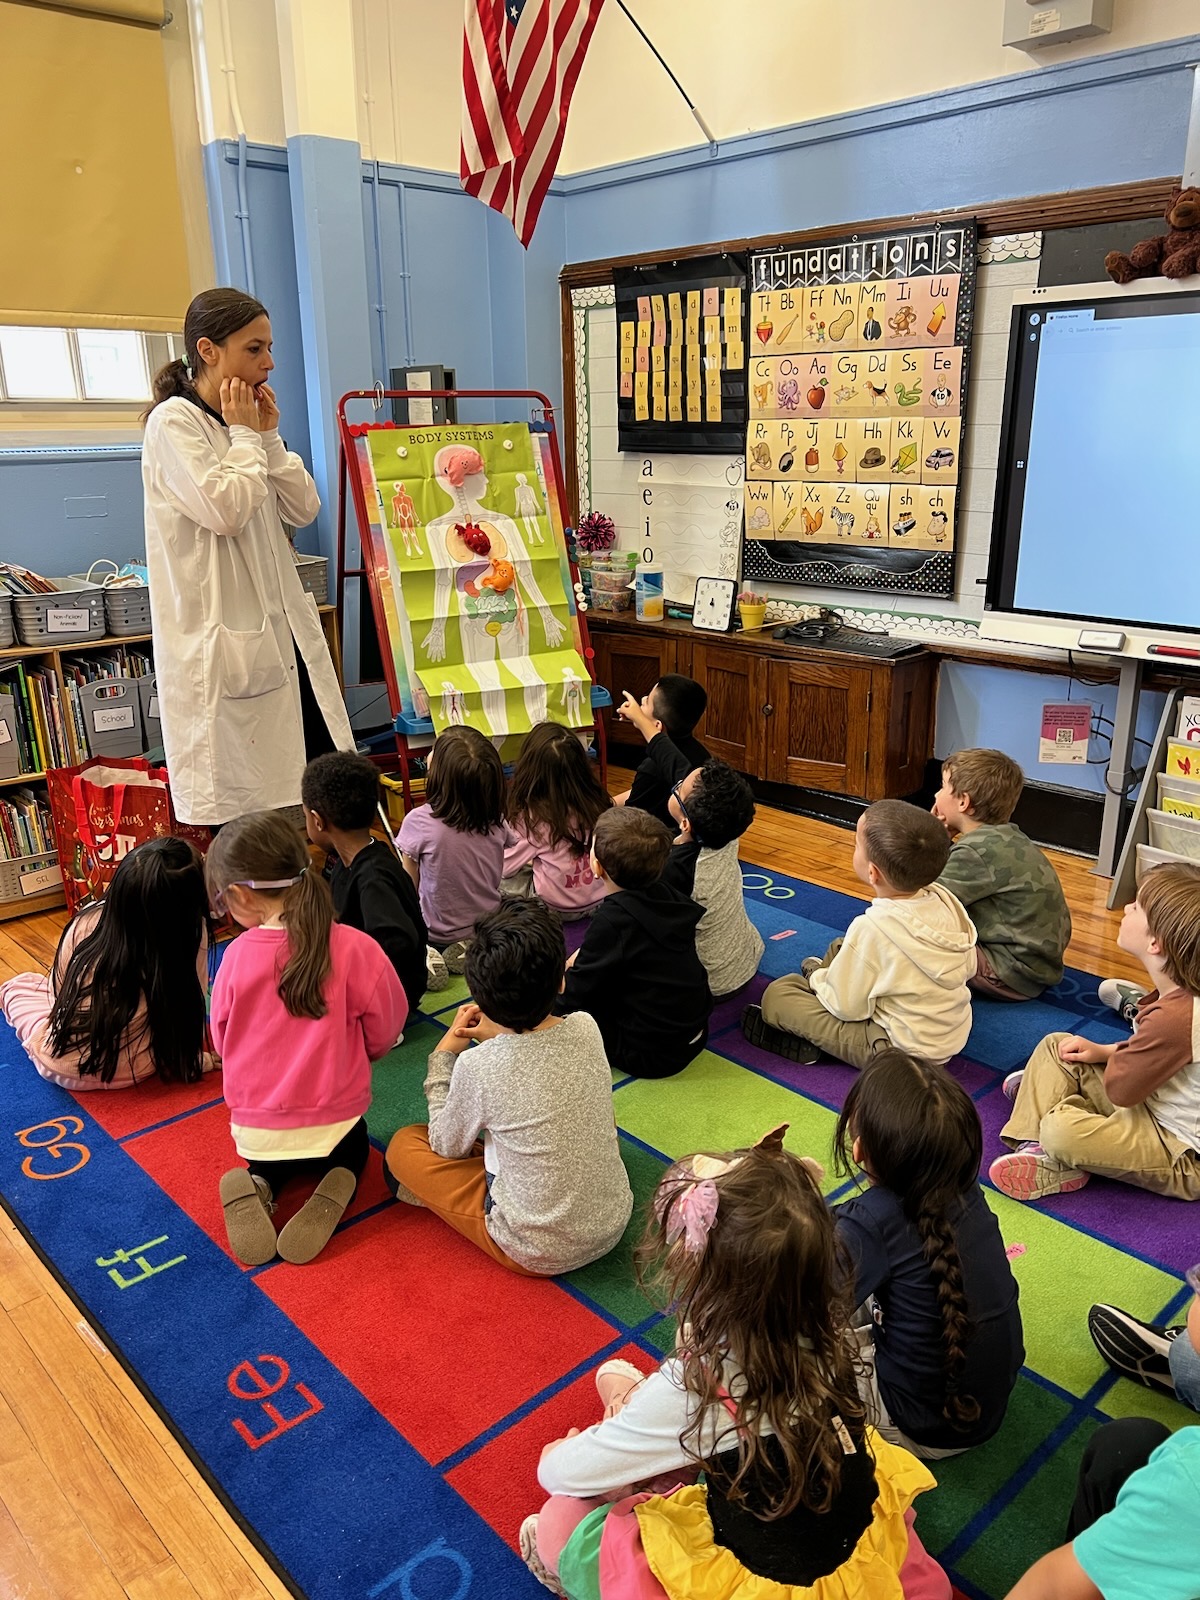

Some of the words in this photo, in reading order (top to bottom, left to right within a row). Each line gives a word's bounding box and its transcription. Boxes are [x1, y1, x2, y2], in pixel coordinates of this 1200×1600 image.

[760, 238, 957, 280] fundations
[656, 303, 662, 312] b
[691, 300, 696, 308] d
[731, 296, 736, 306] f
[758, 295, 774, 312] Tt
[780, 293, 795, 310] Bb
[810, 289, 825, 308] Ff
[833, 288, 852, 306] Nn
[860, 285, 886, 304] Mm
[896, 282, 911, 301] Ii
[930, 279, 949, 298] Uu
[625, 331, 631, 340] g
[641, 329, 647, 338] h
[690, 326, 695, 335] k
[728, 325, 737, 333] m
[656, 356, 661, 365] p
[756, 361, 770, 377] Cc
[780, 359, 799, 376] Oo
[809, 358, 826, 375] Aa
[837, 356, 858, 382] Gg
[868, 355, 887, 373] Dd
[902, 353, 917, 372] Ss
[933, 352, 952, 370] Ee
[691, 380, 697, 389] y
[408, 432, 442, 445] BODY
[446, 430, 495, 442] SYSTEMS
[755, 423, 768, 439] Rr
[780, 423, 795, 447] Pp
[806, 422, 819, 447] Jj
[835, 422, 847, 439] Ll
[864, 422, 882, 439] Hh
[897, 421, 913, 438] Kk
[933, 421, 951, 439] Vv
[642, 459, 654, 477] a
[642, 488, 654, 506] e
[747, 485, 769, 500] Ww
[781, 485, 794, 508] Yy
[804, 486, 821, 503] Xx
[836, 486, 851, 504] Zz
[864, 489, 880, 502] Qu
[900, 488, 913, 505] sh
[928, 489, 944, 507] ch
[866, 503, 877, 516] qu
[645, 516, 651, 537] i
[642, 547, 654, 564] o
[101, 713, 127, 724] School
[15, 1115, 91, 1180] Gg
[96, 1235, 188, 1290] Ff
[227, 1354, 325, 1450] Ee
